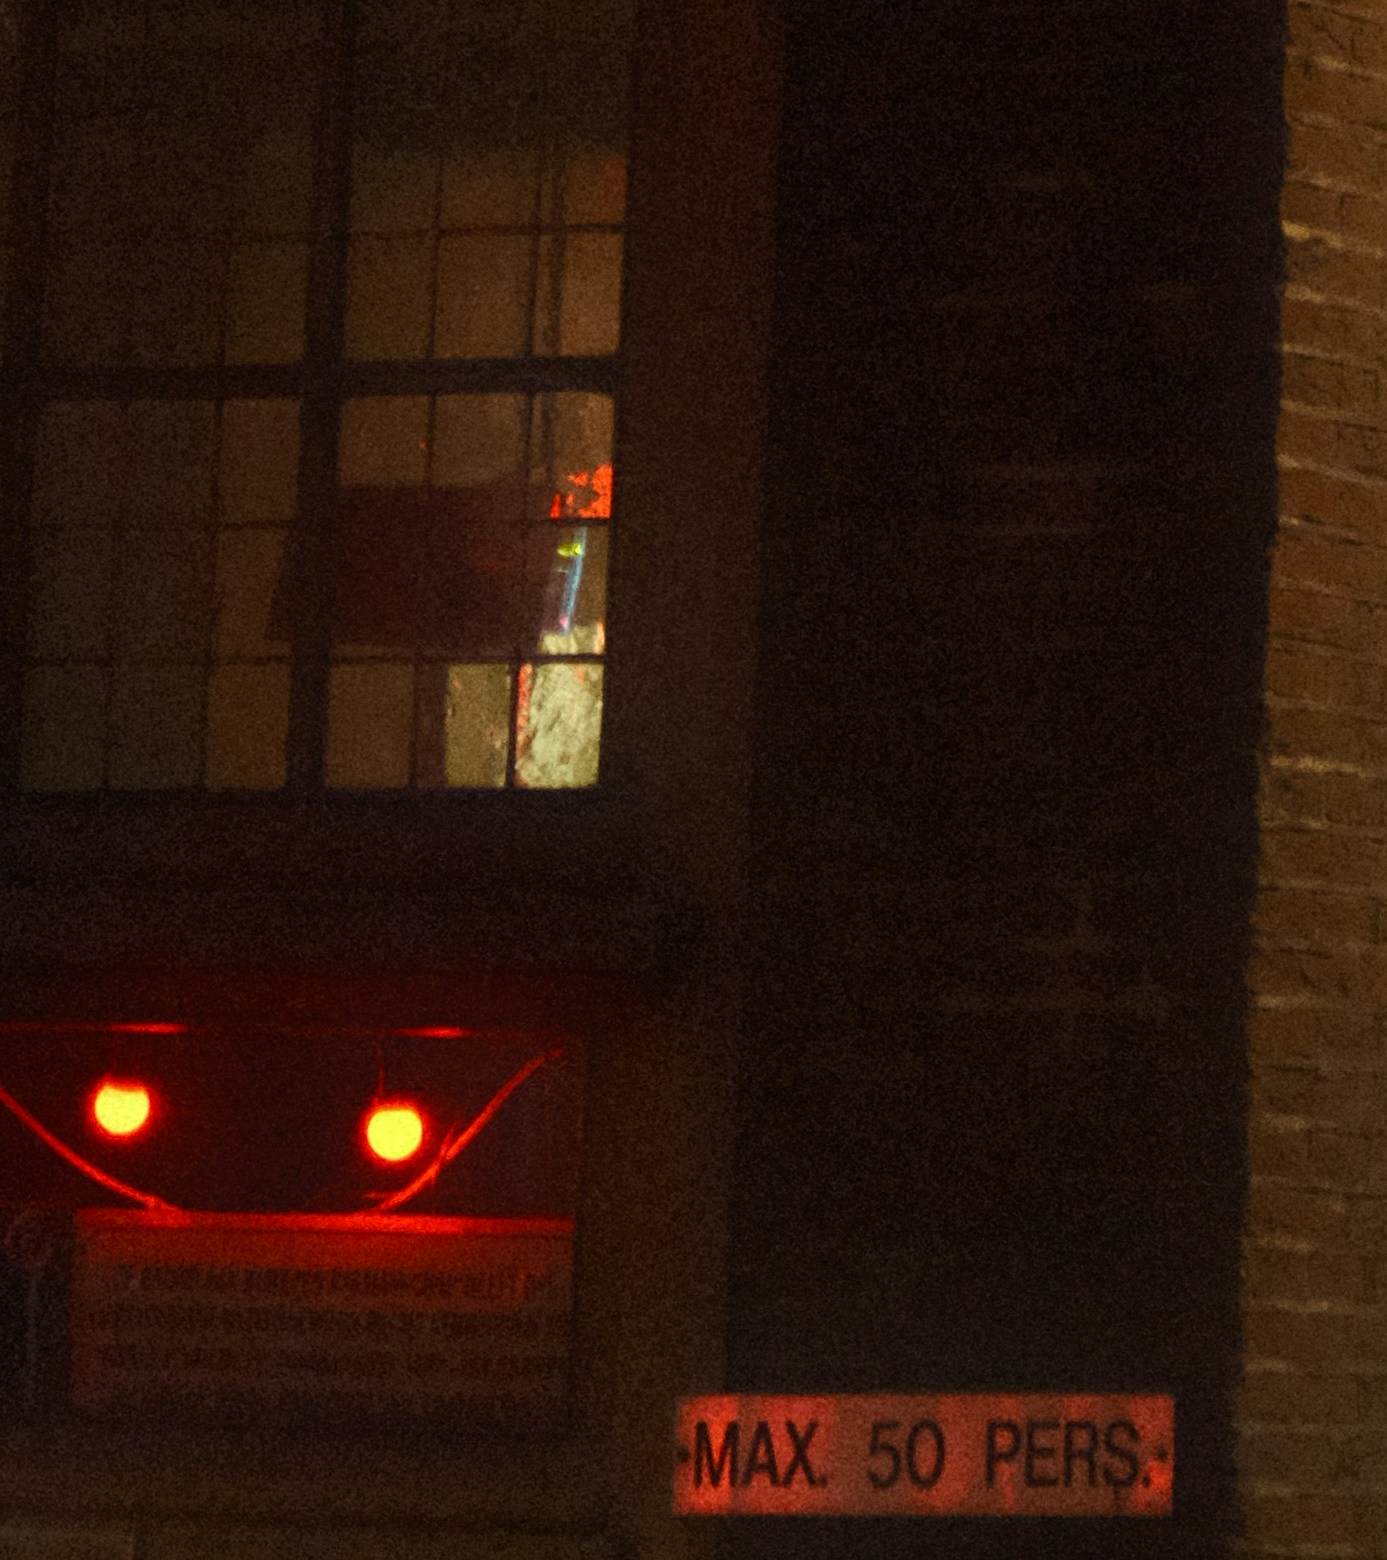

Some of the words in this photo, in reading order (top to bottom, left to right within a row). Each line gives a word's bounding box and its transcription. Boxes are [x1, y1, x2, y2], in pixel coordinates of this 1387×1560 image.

[692, 1419, 828, 1490] MAX.
[867, 1418, 947, 1490] 50
[984, 1419, 1152, 1491] PERS.
